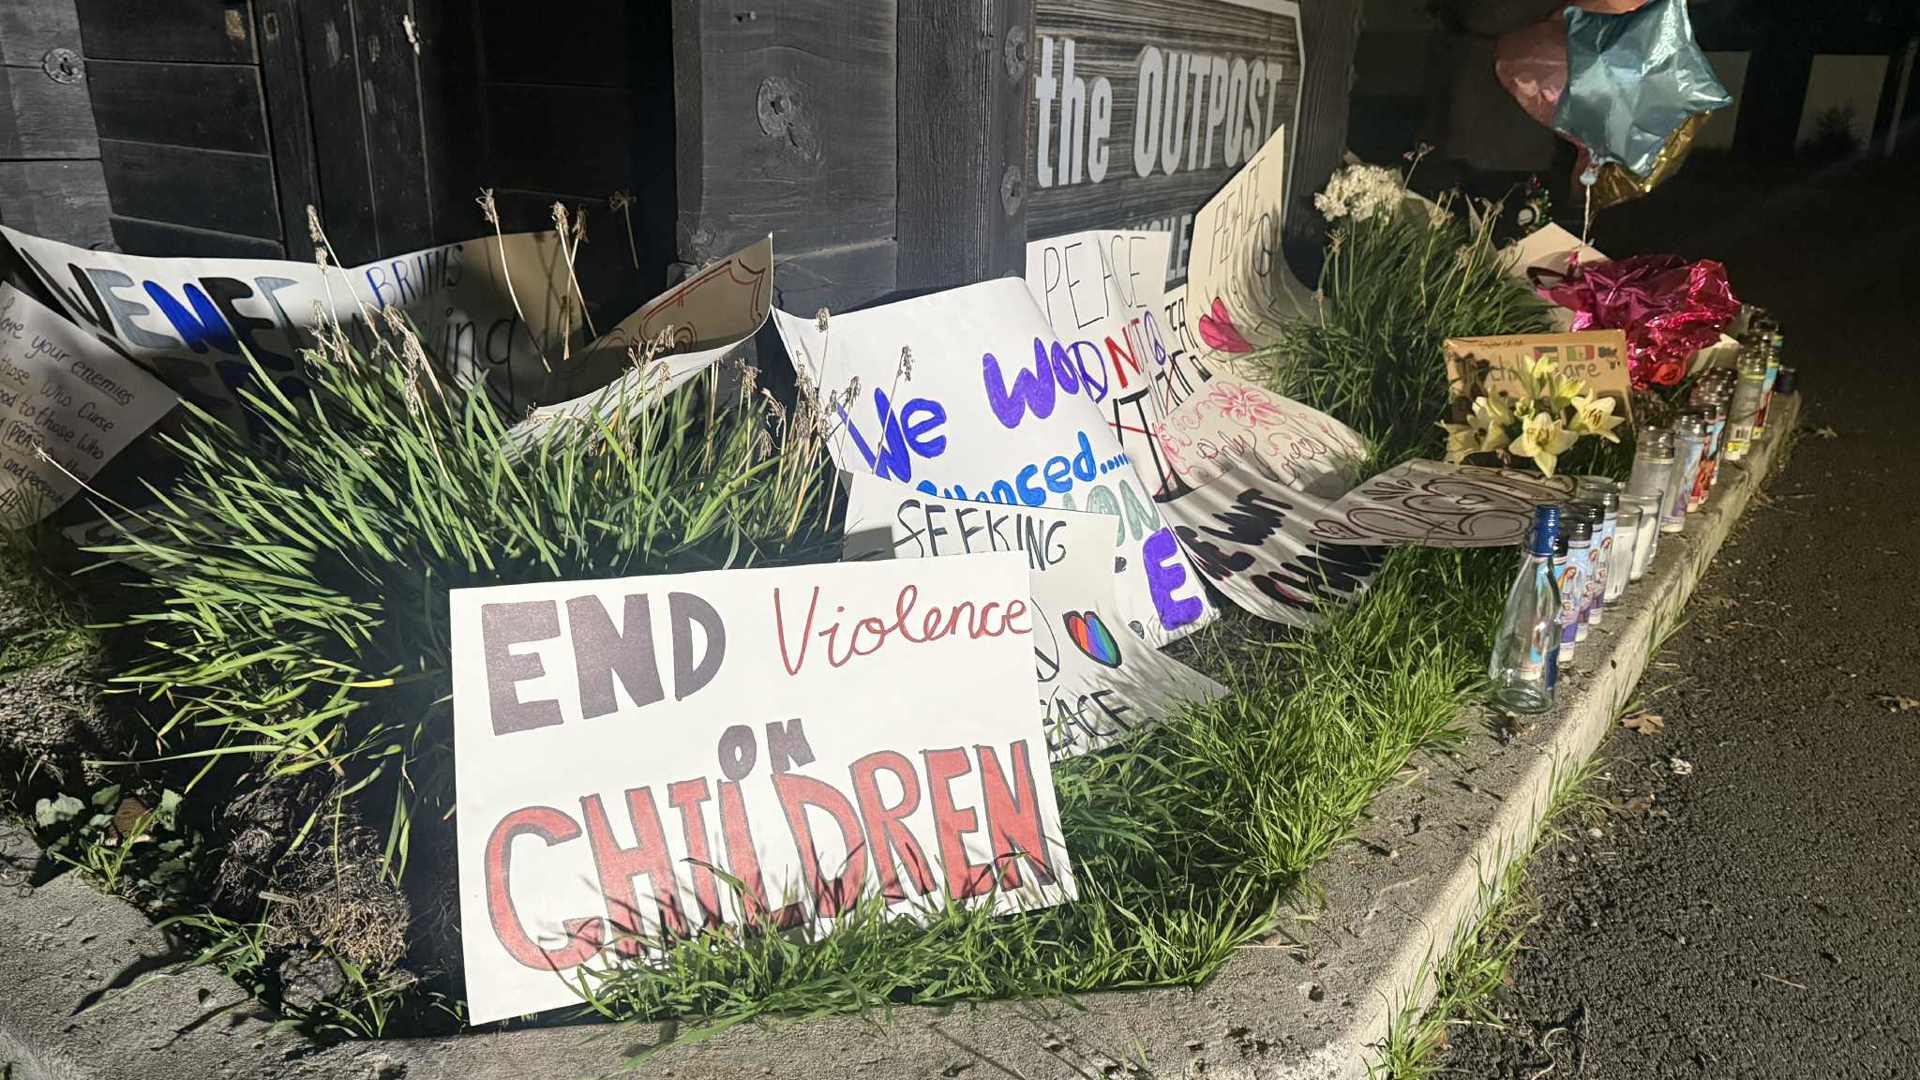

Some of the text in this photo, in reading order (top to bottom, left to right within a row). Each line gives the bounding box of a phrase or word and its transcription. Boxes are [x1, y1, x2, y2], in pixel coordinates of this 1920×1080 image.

[1036, 37, 1283, 188] the OUTPOST
[1044, 234, 1147, 330] PEACE
[25, 336, 71, 360] your
[71, 360, 135, 405] enemies
[835, 387, 947, 483] We
[897, 499, 1067, 572] SEEKING
[481, 585, 1033, 736] END Violence
[718, 718, 816, 782] ON
[485, 740, 1058, 972] CHILDREN
